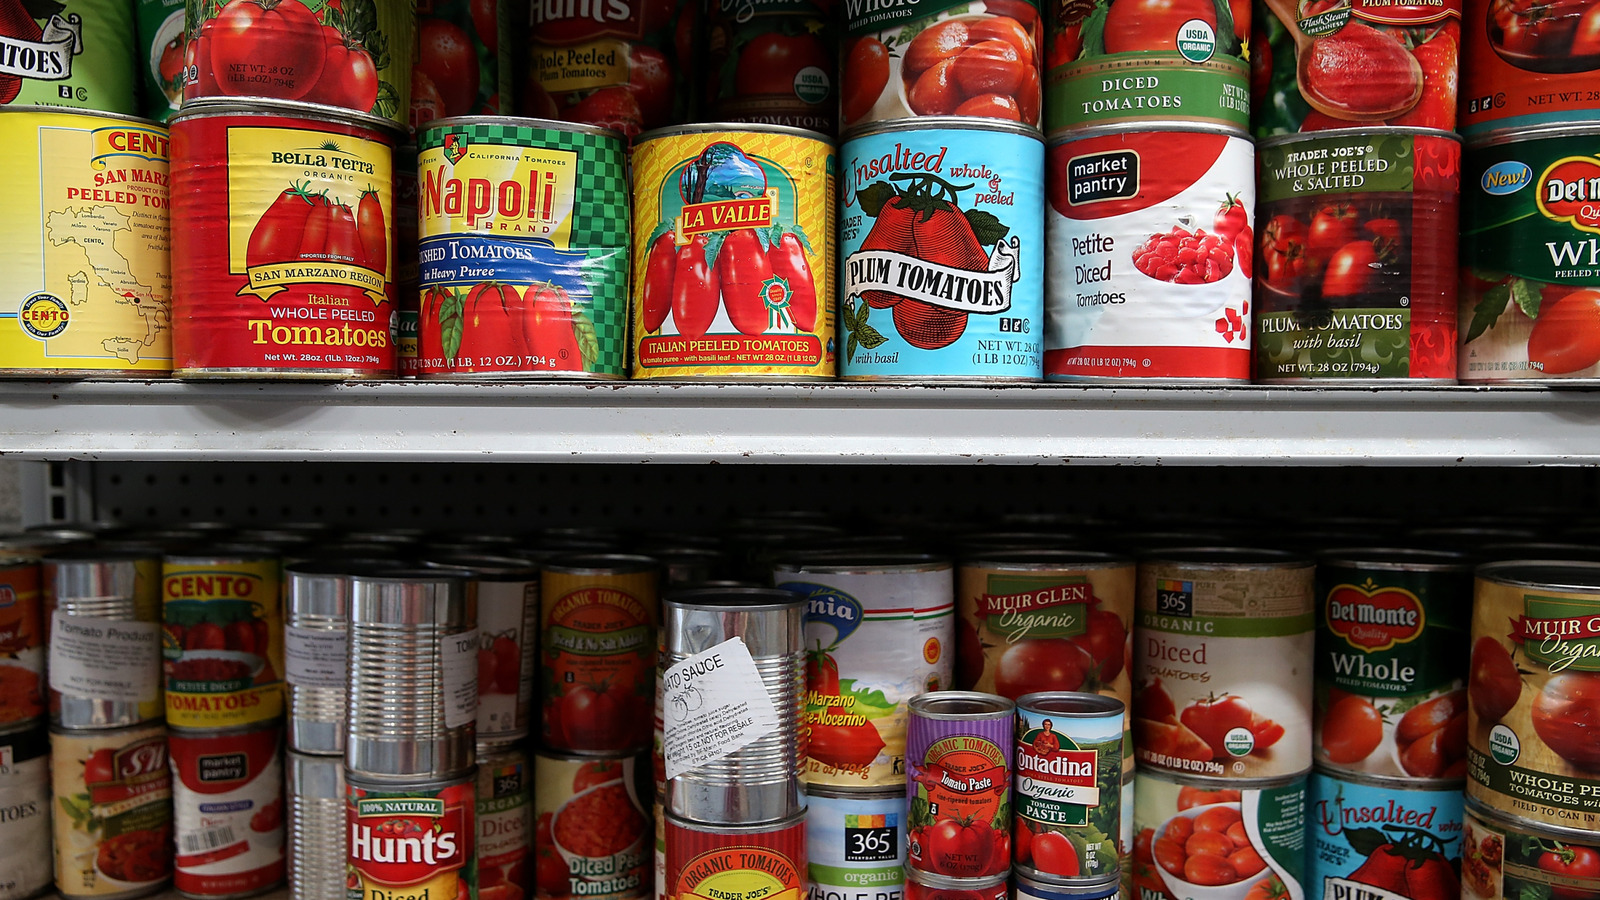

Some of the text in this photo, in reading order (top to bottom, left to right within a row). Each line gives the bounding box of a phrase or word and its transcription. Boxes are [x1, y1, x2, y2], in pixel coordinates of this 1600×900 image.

[870, 9, 912, 23] TOMATOES
[1186, 30, 1208, 40] USDA
[1308, 21, 1344, 34] FRESHNESS
[1183, 43, 1211, 52] ORGANIC
[0, 43, 62, 74] TOES
[567, 48, 615, 66] Peeled
[1100, 60, 1161, 69] PREMIUM
[229, 64, 294, 76] NET 28 OZ
[561, 68, 606, 79] Tomatoes
[274, 78, 294, 88] 794g
[802, 75, 823, 84] USDA
[1102, 76, 1159, 91] DICED
[1082, 96, 1181, 113] TOMATOES
[1528, 94, 1555, 106] NET
[109, 132, 169, 157] CENT
[469, 153, 566, 165] CALIFORNIA TOMATOES
[1287, 146, 1365, 163] TRADER JOE'S
[1075, 157, 1127, 176] market
[1275, 159, 1389, 180] WHOLE PEELED
[94, 169, 169, 187] SAN MARZ
[304, 171, 354, 181] ORGANIC
[842, 143, 991, 208] Unsalted whole
[988, 173, 1001, 193] &
[1293, 175, 1364, 191] & SALTED
[1486, 168, 1527, 188] New!
[67, 188, 137, 205] PEELED
[1075, 177, 1127, 199] pantry
[1548, 178, 1586, 202] Del
[974, 192, 1014, 207] peeled
[683, 204, 770, 228] LA VALLE
[486, 222, 549, 233] BRAND
[449, 241, 533, 260] TOMATOES
[1072, 233, 1114, 257] Petite
[255, 269, 382, 288] SAN MARZANO REGION
[425, 266, 494, 281] in Heavy Puree
[1075, 260, 1111, 285] Diced
[1555, 270, 1592, 278] PEELED
[850, 259, 1004, 306] PLUM TOMATOES
[308, 294, 349, 306] Italian
[1076, 291, 1126, 307] Tomatoes
[22, 311, 69, 321] CENTO
[270, 308, 375, 322] WHOLE PEELED
[248, 320, 386, 348] Tomatoes
[1293, 333, 1362, 349] with basil
[649, 340, 809, 353] ITALIAN PEELED TOMATOES
[978, 340, 1002, 351] NET
[366, 356, 379, 364] 794g
[479, 357, 492, 366] 12
[855, 352, 899, 364] with basil
[985, 355, 1012, 364] LB 12
[1123, 358, 1136, 368] 794g
[1529, 362, 1544, 370] 794g
[1278, 363, 1380, 374] NET WT. 28 OZ (794g)
[167, 576, 253, 598] CENTO
[552, 591, 646, 619] ORGANIC TOMATOES
[988, 587, 1085, 610] MUIR GLEN
[1161, 593, 1186, 611] 365
[1331, 601, 1417, 626] Del Monte
[59, 620, 155, 642] Tomato Product
[1000, 607, 1076, 645] Organic
[1144, 616, 1214, 633] ORGANIC
[1525, 620, 1581, 635] MUIR
[585, 639, 598, 649] No
[600, 637, 617, 649] Salt
[1148, 638, 1207, 665] Diced
[1540, 633, 1600, 675] Orga
[682, 654, 724, 682] SAUCE
[1147, 665, 1211, 683] TOMATOES
[1330, 652, 1415, 683] Whole
[1362, 681, 1406, 692] TOMATOES
[167, 691, 260, 711] TOMATOES
[809, 691, 855, 707] Marzano
[715, 730, 728, 739] FOR
[728, 717, 754, 734] RESALE
[718, 738, 730, 746] Food
[1494, 732, 1512, 745] USDA
[928, 738, 1003, 765] ORGANIC TOMATOES
[1492, 743, 1515, 757] ORGANIC
[203, 756, 241, 767] market
[945, 762, 967, 772] TRADER
[1017, 746, 1092, 777] Contadina
[203, 766, 242, 779] pantry
[941, 771, 992, 791] Tomato Paste
[1022, 778, 1075, 800] Organic
[1509, 770, 1574, 794] WHOLE
[1509, 783, 1579, 805] TOMATOES
[362, 802, 438, 812] 100% NATURAL
[1026, 805, 1067, 822] PASTE
[1030, 800, 1060, 810] TOMATO
[1513, 800, 1595, 822] FIELD TO CAN IN
[1314, 797, 1437, 836] Unsalted
[852, 832, 890, 854] 365
[569, 857, 615, 874] Diced
[945, 853, 963, 862] NET
[685, 854, 794, 889] ORGANIC TOMATOES
[844, 870, 898, 884] organic
[569, 874, 640, 894] Tomatoes
[371, 888, 429, 900] Diced
[709, 887, 769, 900] TRADER JOE'S
